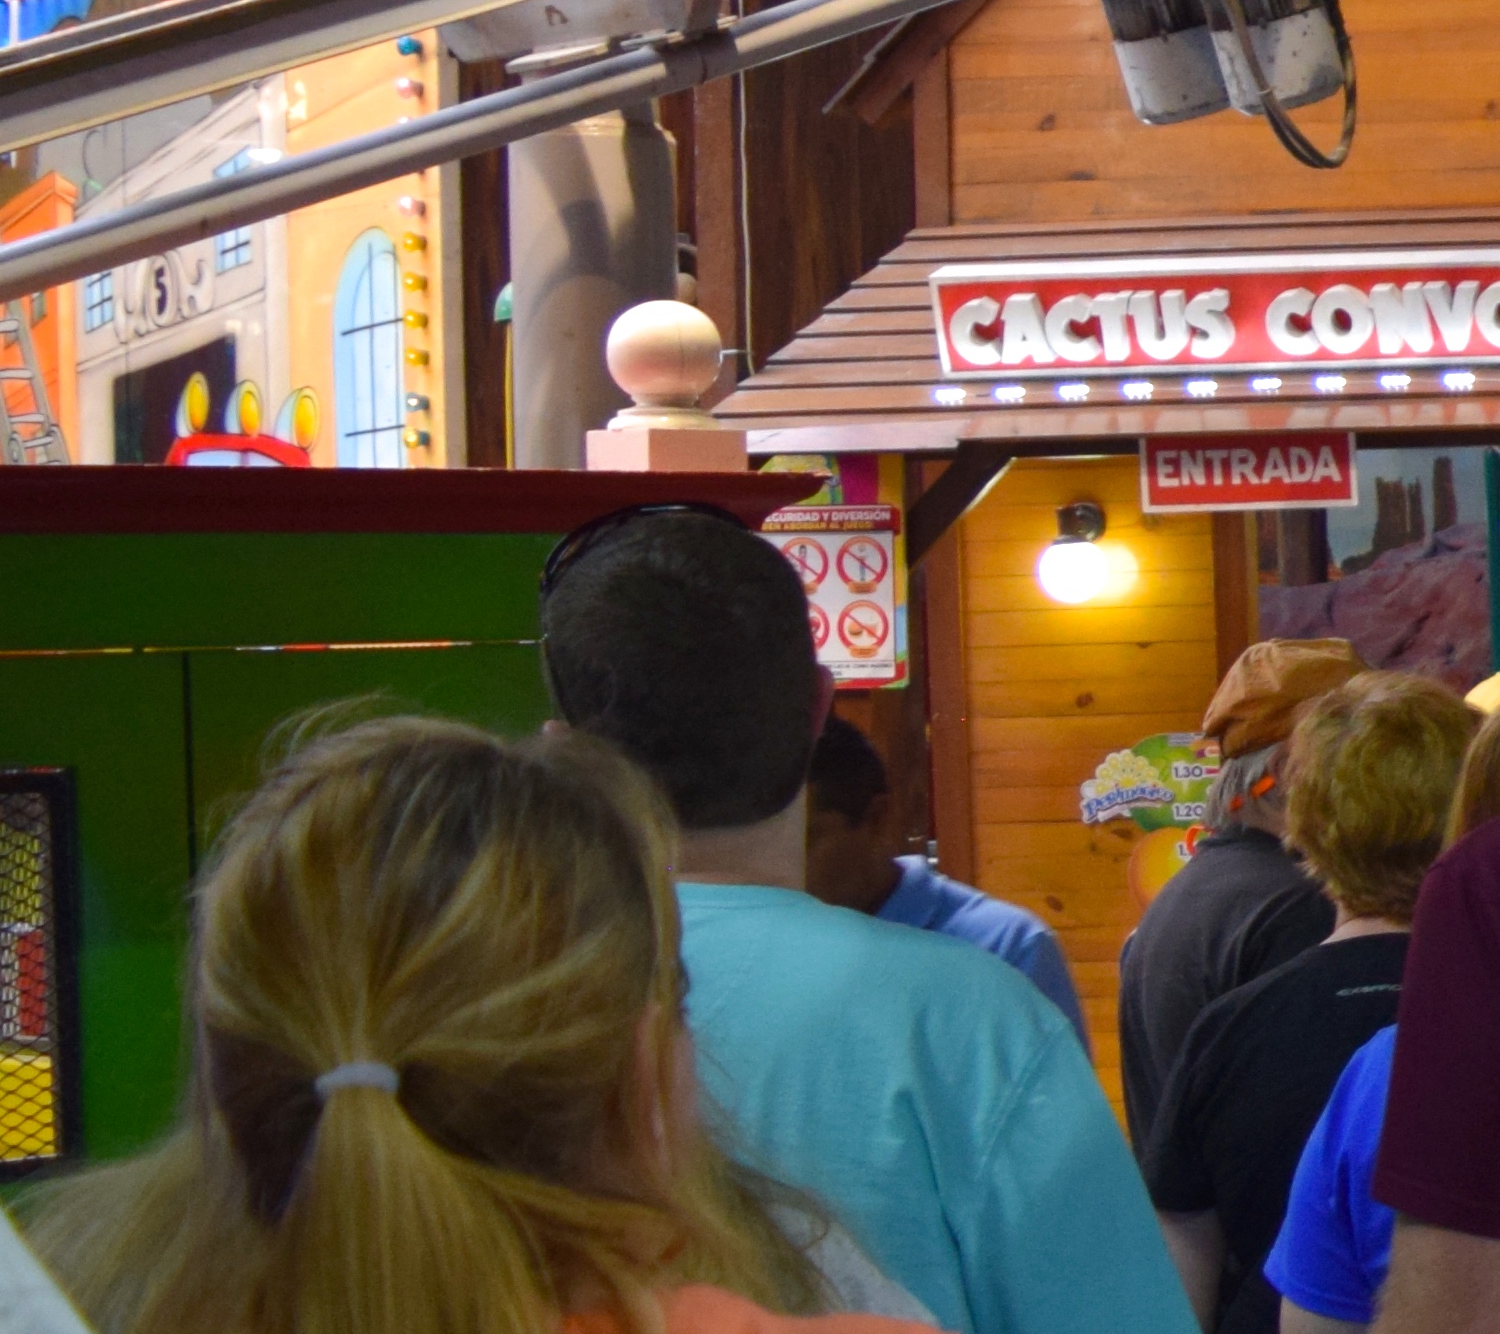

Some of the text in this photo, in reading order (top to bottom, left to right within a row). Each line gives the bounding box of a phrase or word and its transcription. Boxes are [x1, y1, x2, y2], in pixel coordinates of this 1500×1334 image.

[949, 288, 1236, 365] CACTUS
[1156, 445, 1343, 487] ENTRADA
[1173, 767, 1203, 779] 1.30
